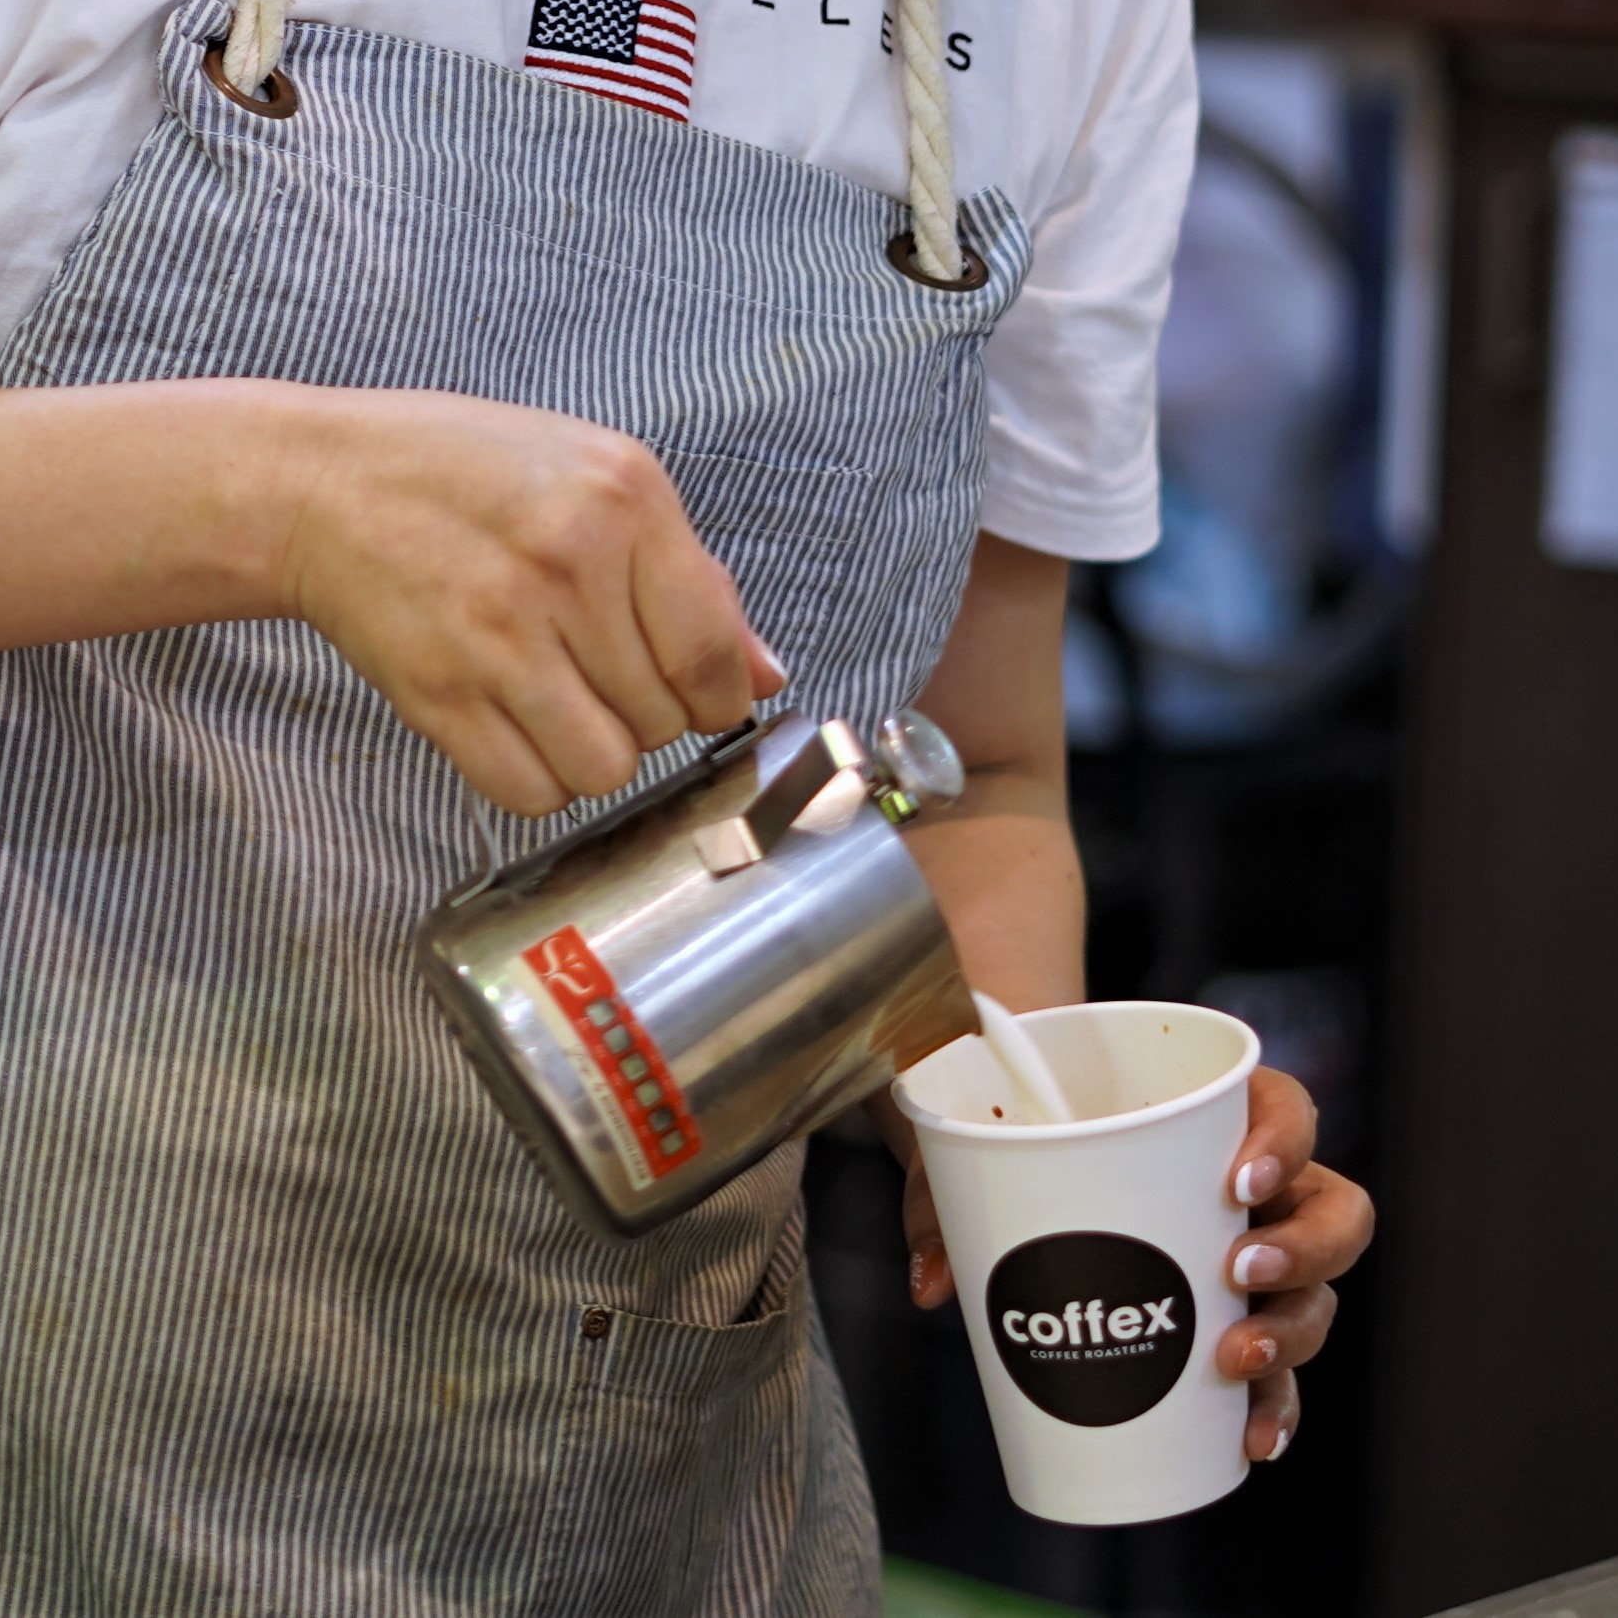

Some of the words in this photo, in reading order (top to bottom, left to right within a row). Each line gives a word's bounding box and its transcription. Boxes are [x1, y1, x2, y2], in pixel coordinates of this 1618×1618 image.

[1002, 1296, 1178, 1345] coffex
[1029, 1349, 1080, 1360] COFFEE
[1084, 1340, 1155, 1360] ROASTERS
